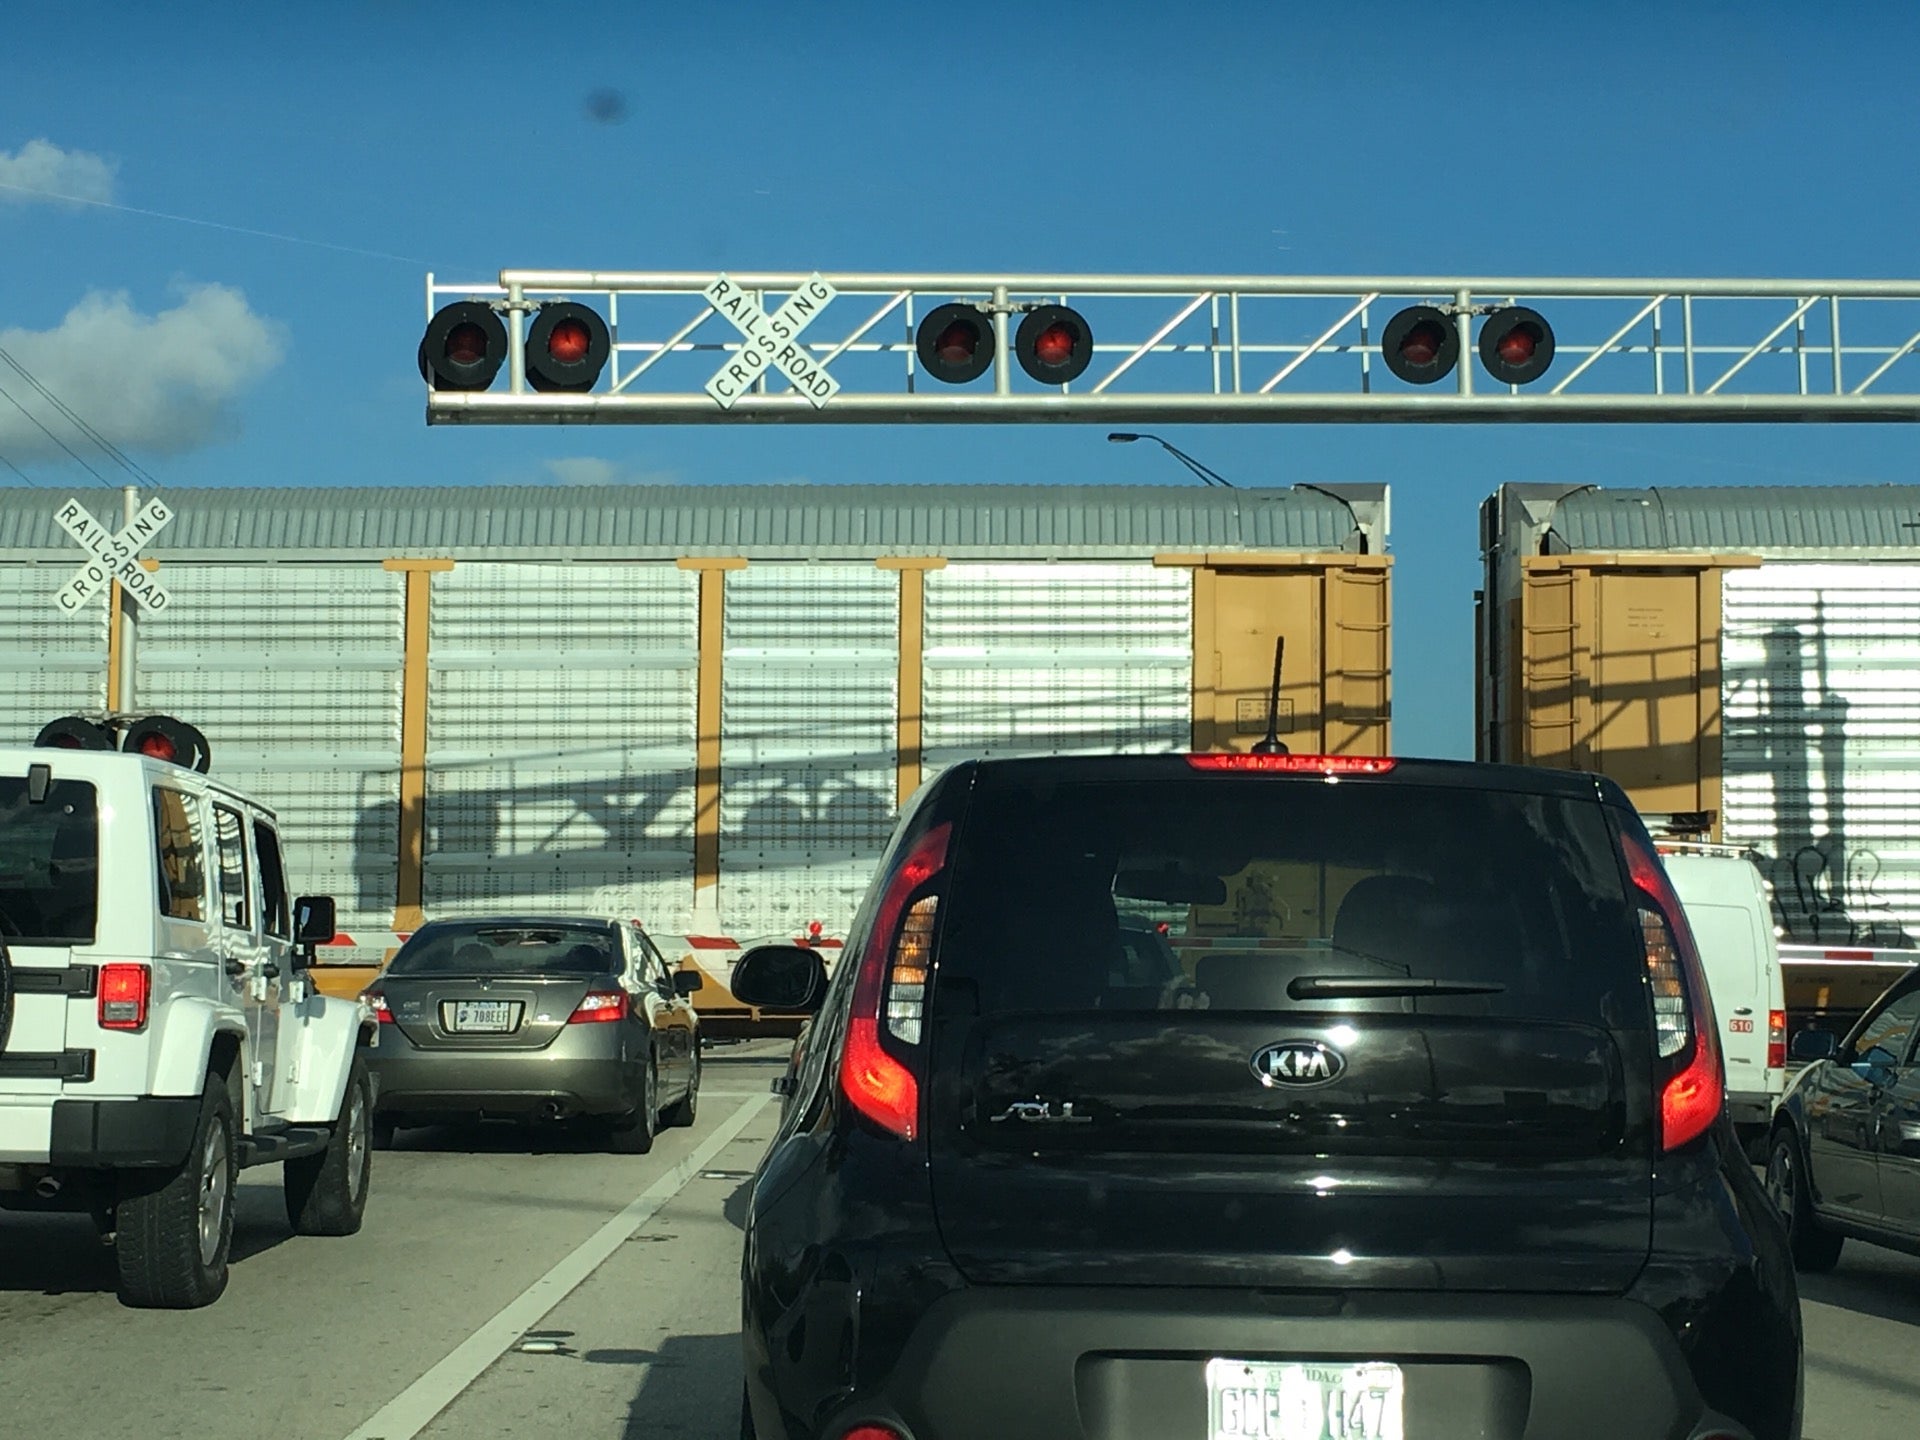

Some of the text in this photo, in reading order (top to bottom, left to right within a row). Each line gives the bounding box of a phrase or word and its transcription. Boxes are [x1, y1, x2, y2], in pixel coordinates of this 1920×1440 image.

[710, 280, 831, 397] RAIL ROAD
[715, 281, 828, 397] CROSSING
[60, 505, 166, 609] RAIL ROAD
[60, 505, 166, 610] CROSSING
[1269, 1050, 1331, 1077] KIA
[1730, 1020, 1752, 1032] 610
